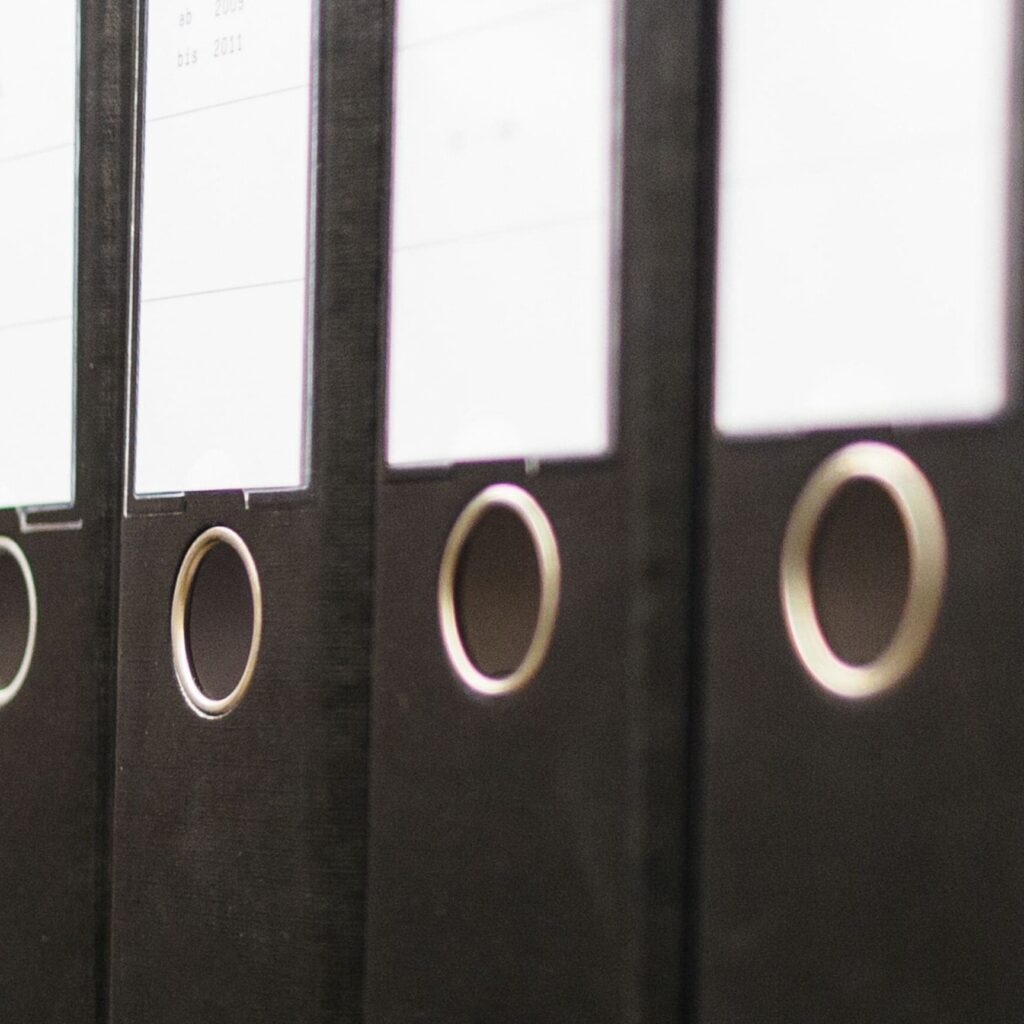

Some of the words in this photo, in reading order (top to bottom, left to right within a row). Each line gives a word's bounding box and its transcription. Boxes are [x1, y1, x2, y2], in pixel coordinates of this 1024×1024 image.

[178, 8, 192, 27] ab
[177, 49, 198, 68] bis
[214, 34, 243, 58] 2011
